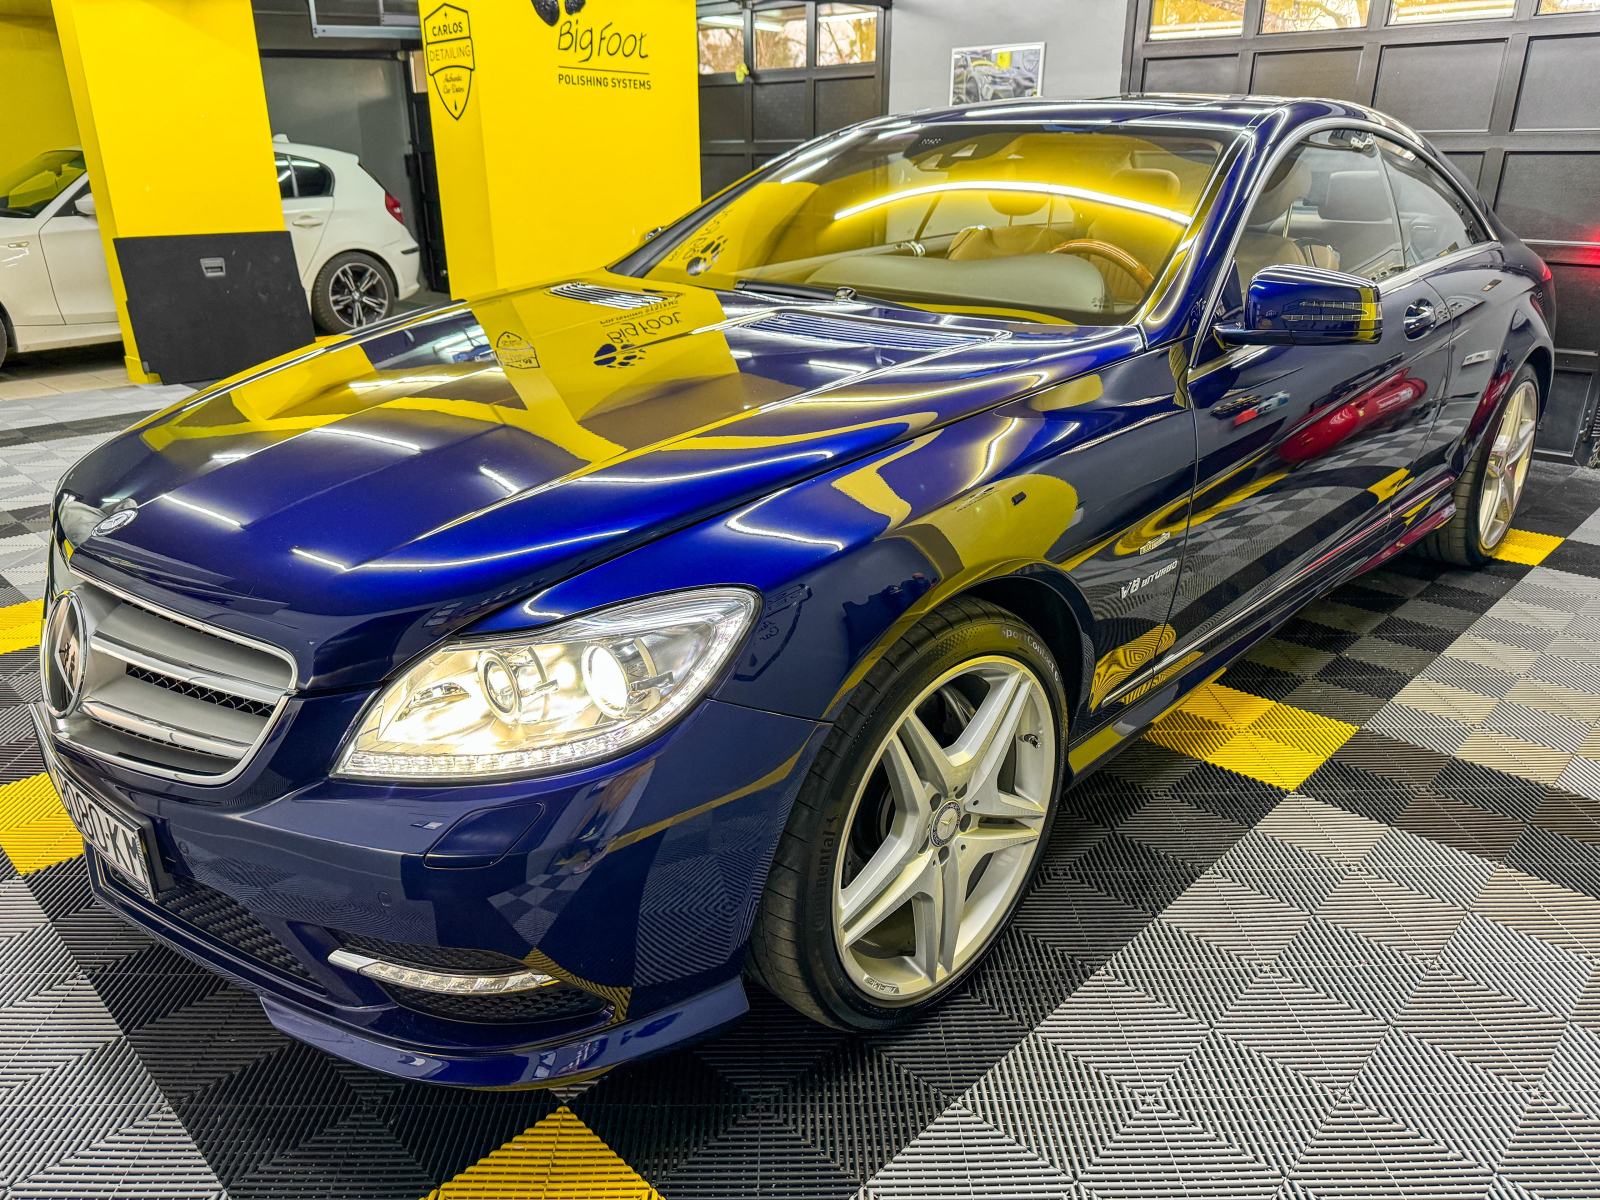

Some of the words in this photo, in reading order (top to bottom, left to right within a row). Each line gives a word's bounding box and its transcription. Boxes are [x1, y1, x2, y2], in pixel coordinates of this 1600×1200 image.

[432, 21, 463, 37] CARLOS
[429, 44, 471, 62] DETAILING
[558, 74, 609, 88] POLISHING
[611, 77, 652, 90] SYSTEMS
[1120, 577, 1141, 599] V8
[1141, 560, 1178, 588] BITURBO
